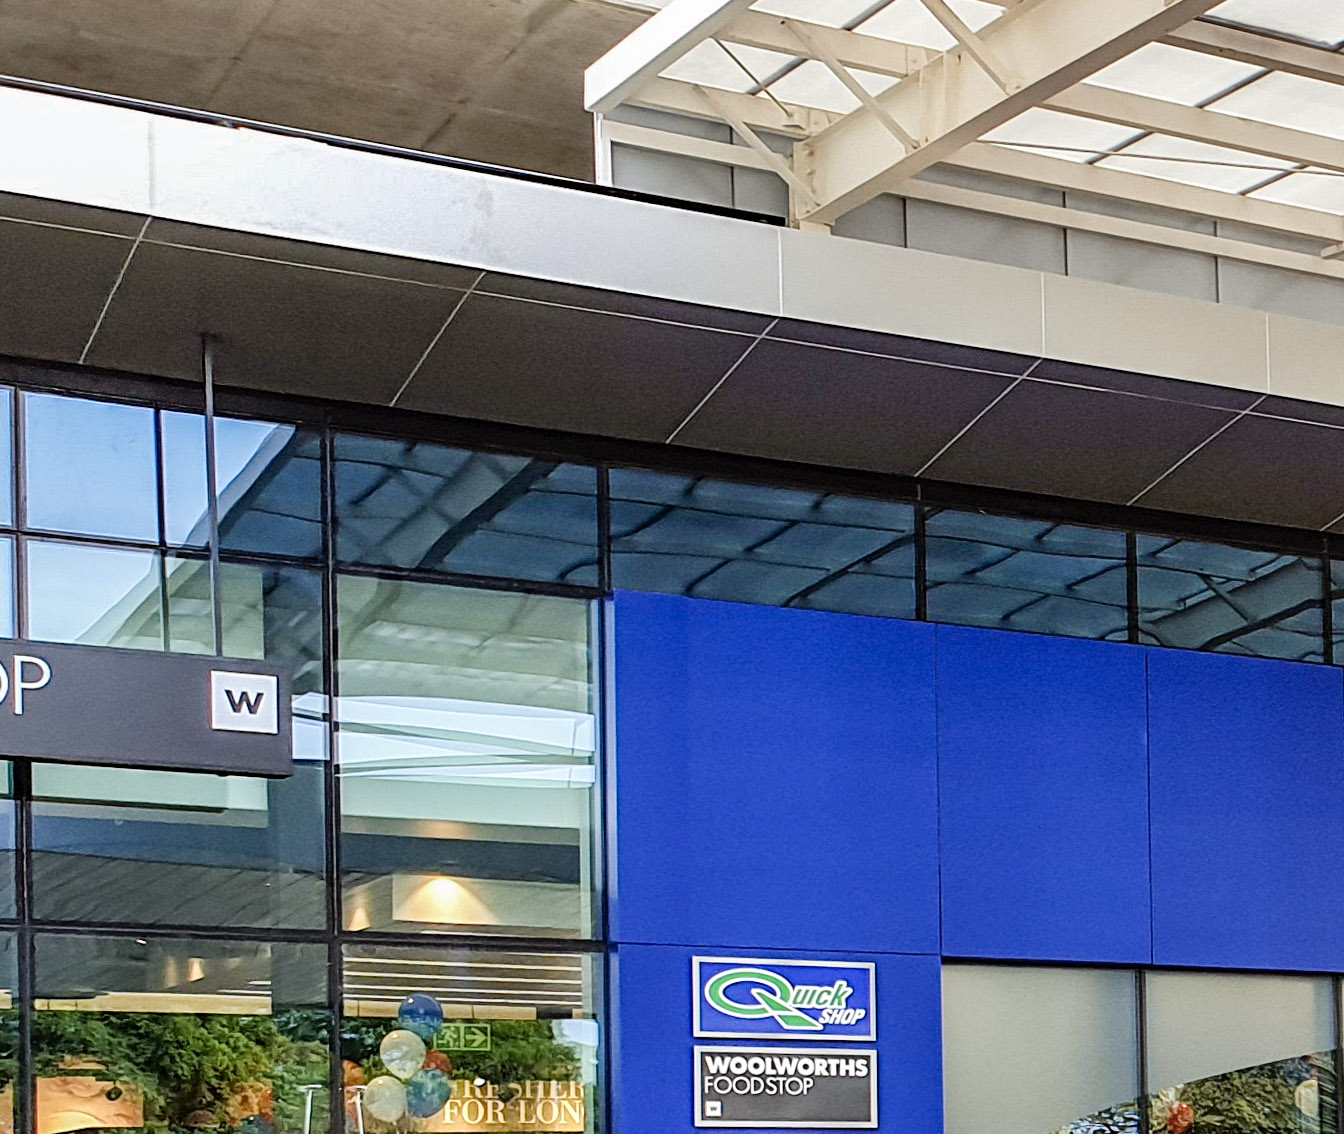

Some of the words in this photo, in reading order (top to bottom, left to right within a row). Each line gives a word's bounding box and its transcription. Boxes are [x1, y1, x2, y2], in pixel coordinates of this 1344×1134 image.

[818, 1008, 866, 1025] SHOP
[704, 1055, 869, 1077] WOOLWORTHS
[442, 1099, 506, 1124] FOR
[517, 1099, 585, 1124] LON
